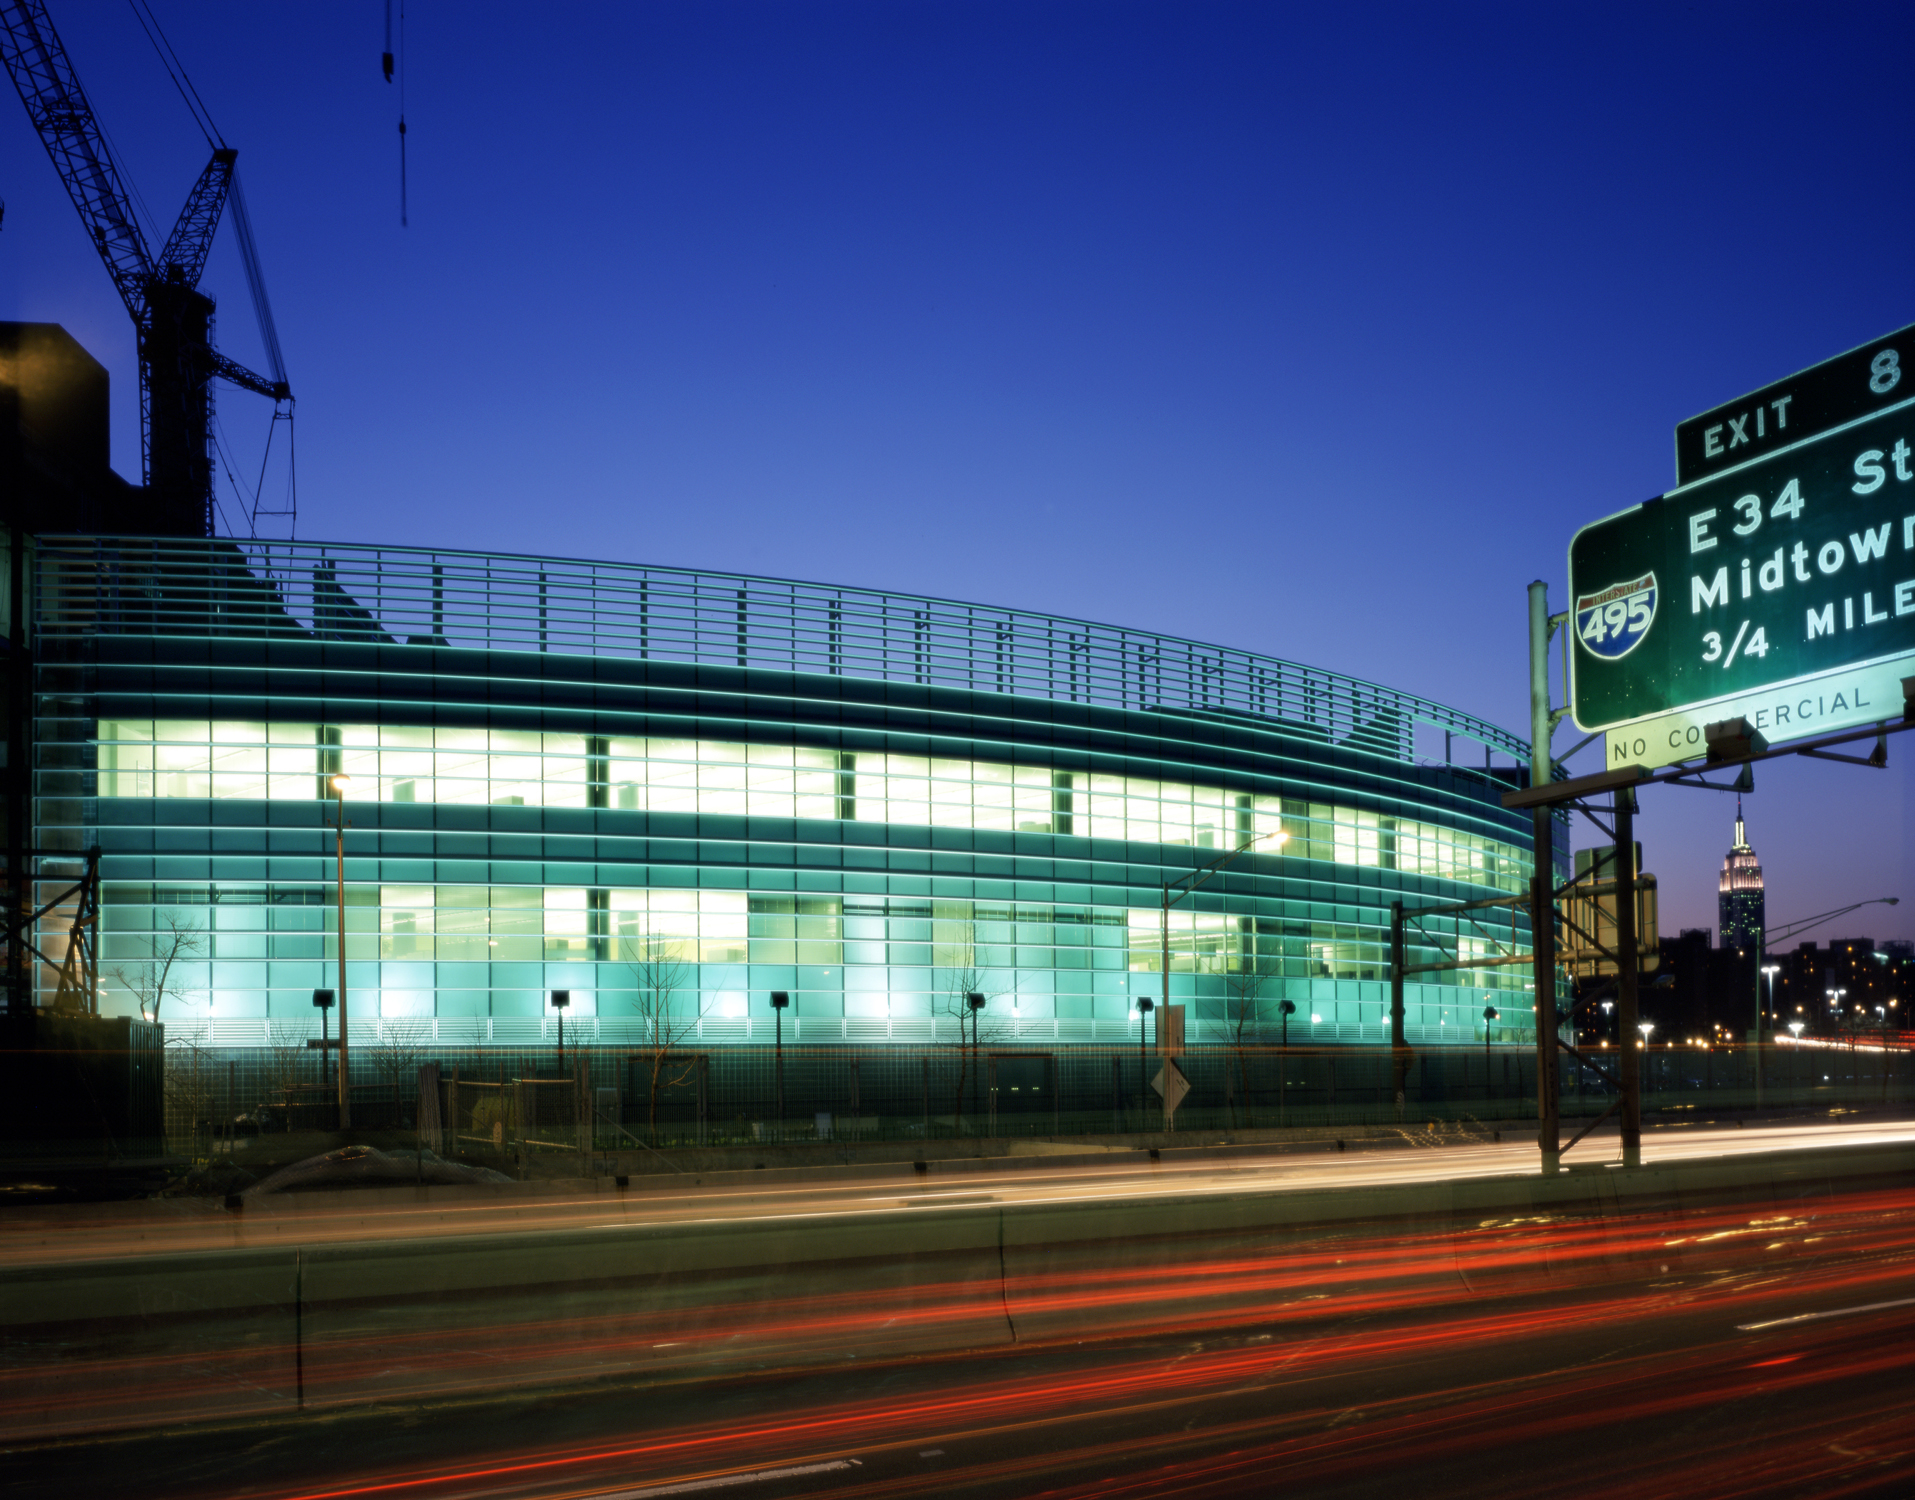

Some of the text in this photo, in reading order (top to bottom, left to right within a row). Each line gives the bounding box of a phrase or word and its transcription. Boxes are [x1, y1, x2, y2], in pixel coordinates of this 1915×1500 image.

[1704, 349, 1901, 458] EXIT 8
[1689, 438, 1914, 553] E 34 St
[1582, 592, 1652, 643] 495
[1592, 583, 1638, 606] INTERSTATE
[1702, 579, 1915, 668] 3/4 MILE
[1614, 688, 1871, 761] NO COERCIAL
